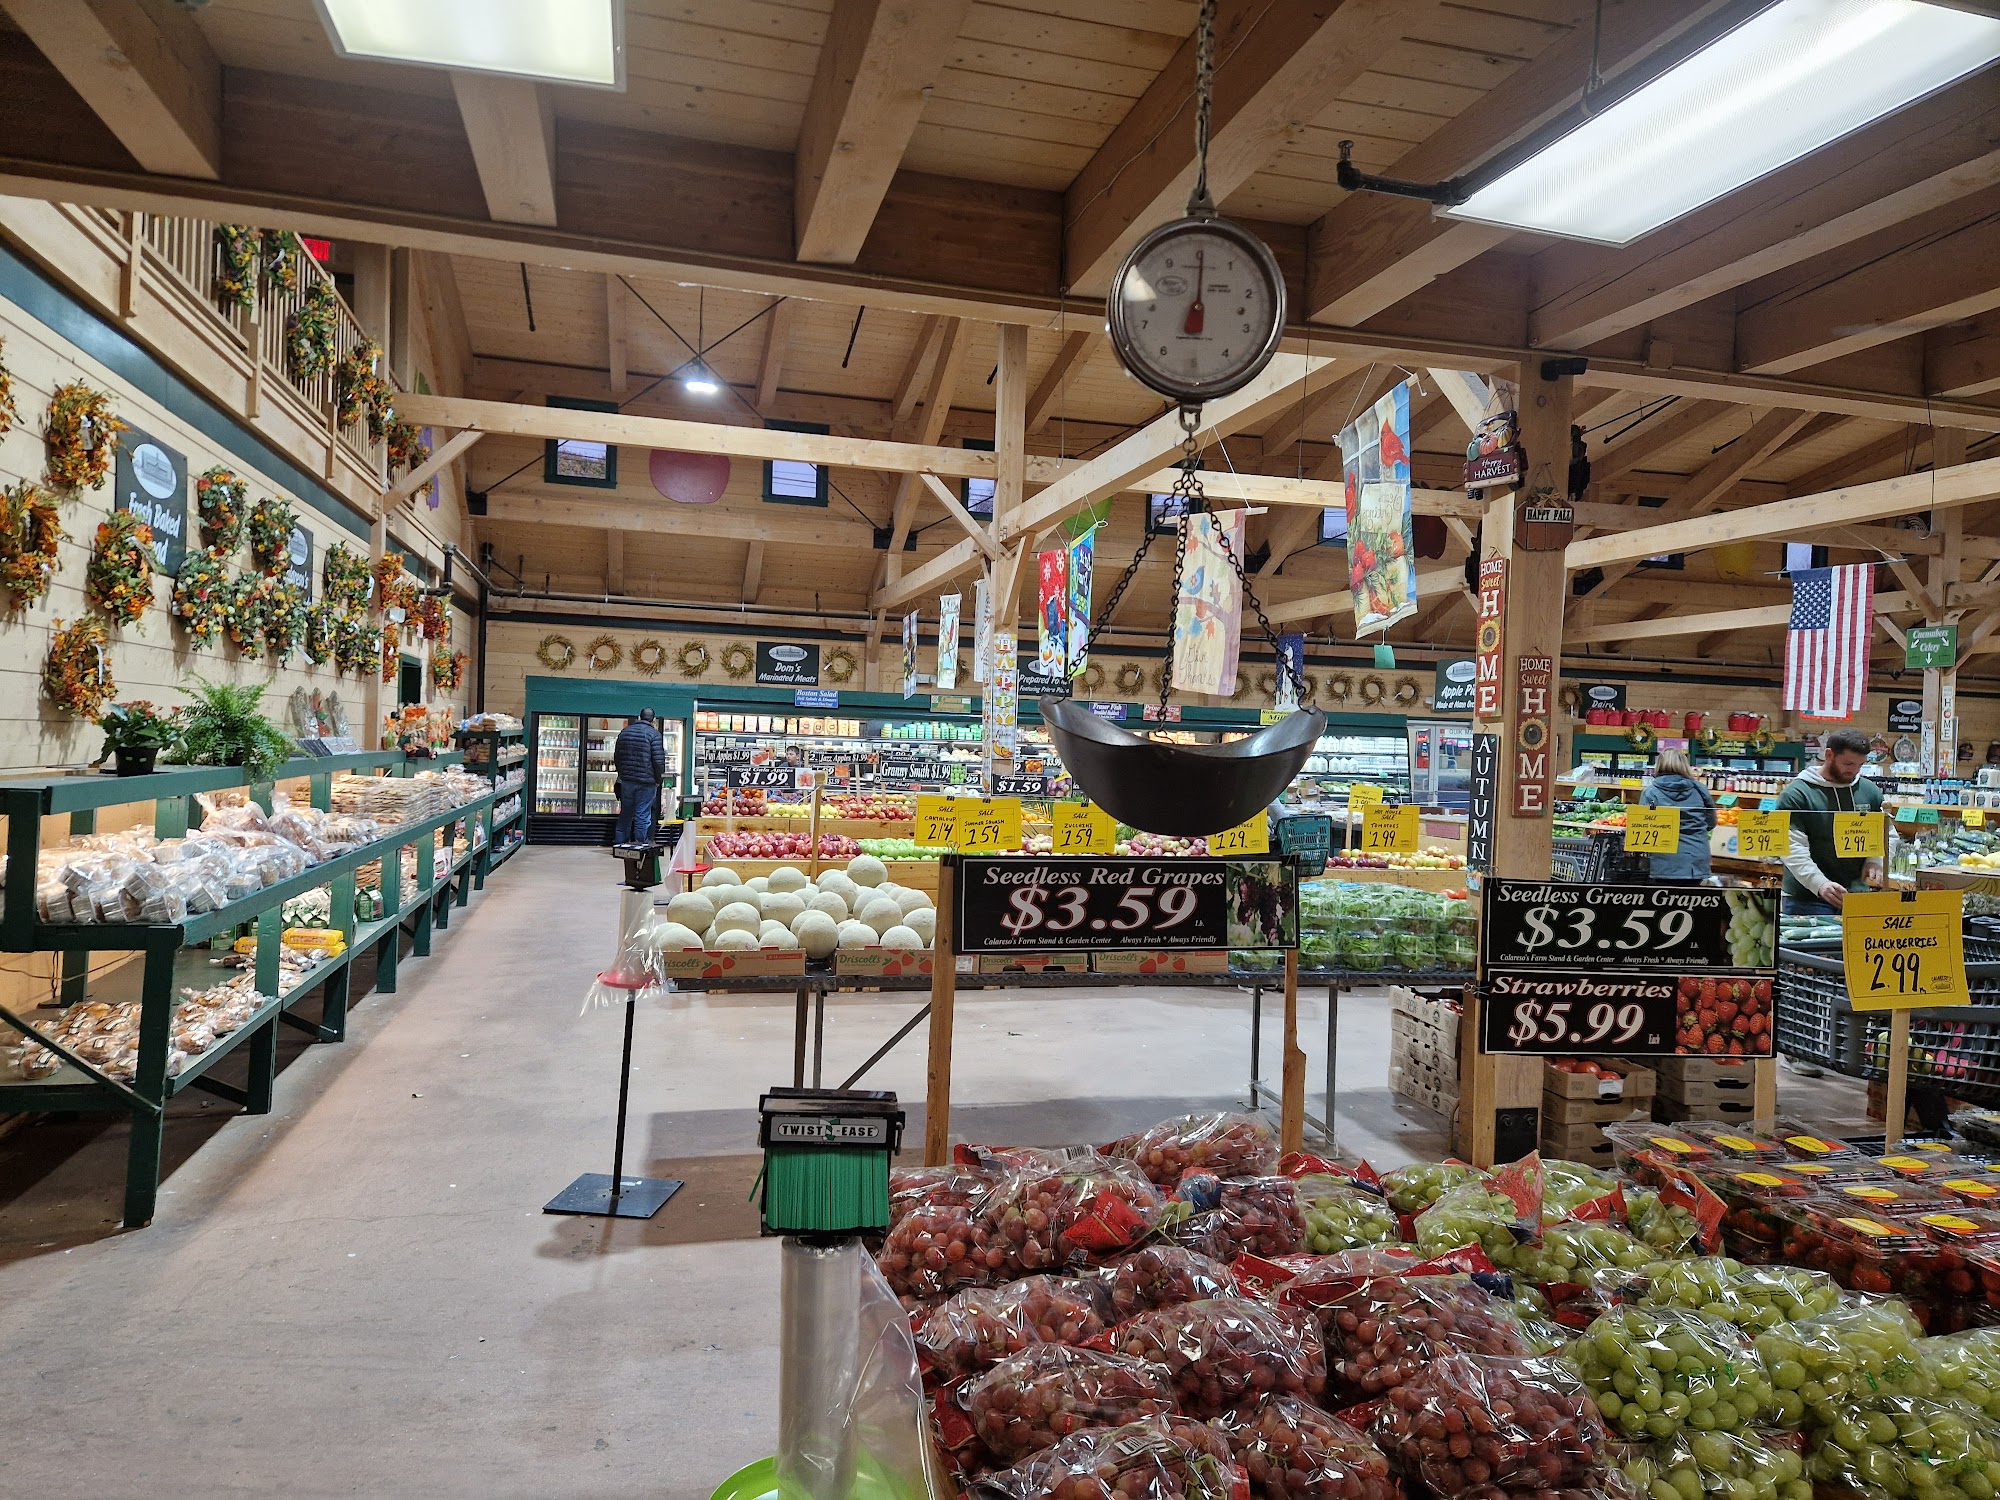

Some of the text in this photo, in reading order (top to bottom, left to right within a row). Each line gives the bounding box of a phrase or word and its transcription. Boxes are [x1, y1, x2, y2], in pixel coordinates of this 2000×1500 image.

[1246, 289, 1253, 299] 2
[1242, 324, 1250, 334] 3
[1160, 346, 1168, 356] 6
[1221, 349, 1229, 358] 4
[1481, 458, 1502, 469] Happy
[1474, 464, 1511, 479] HARVEST
[1527, 509, 1572, 521] HAPPY FALL
[153, 504, 181, 539] Baked
[1480, 559, 1503, 577] HOME
[1920, 642, 1940, 653] Celery
[774, 662, 801, 673] Dom's
[1520, 658, 1550, 673] HOME
[758, 672, 817, 684] Marinated Meats
[1018, 674, 1050, 685] Prepared
[1441, 684, 1463, 699] Apple
[1436, 701, 1449, 709] Made
[1890, 714, 1909, 722] Garden
[705, 750, 750, 764] Fuji Apples $1.99
[820, 753, 867, 763] Jazz Apples $1.99
[882, 762, 951, 781] Granny Smith $1.99
[738, 771, 789, 786] $1.99
[996, 781, 1042, 794] $1.59
[1470, 735, 1493, 862] AUTUMN
[983, 866, 1225, 889] Seedless Red Grapes
[1497, 884, 1721, 910] Seedless Green Grapes
[1000, 882, 1198, 936] $3.59
[1515, 904, 1694, 953] $3.59
[1882, 916, 1914, 930] SALE
[983, 935, 1217, 946] Calareso's Farm Stand & Garden Center Always Fresh Always Friendly
[1864, 936, 1938, 951] BLACKBERRIES
[664, 958, 700, 968] riscoll's
[839, 954, 881, 964] Driscoll's
[982, 956, 1013, 965] Driscoll's
[1098, 952, 1137, 962] Driscoll's
[1500, 954, 1530, 962] Calareso's
[1573, 955, 1595, 963] Garden
[1622, 956, 1642, 964] Always
[1665, 956, 1685, 964] Always
[1686, 957, 1709, 965] Friendly
[1865, 953, 1920, 993] $2.99
[1491, 975, 1674, 998] Strawberries
[1507, 998, 1661, 1046] $5.99 Each
[782, 1125, 823, 1135] TWIST
